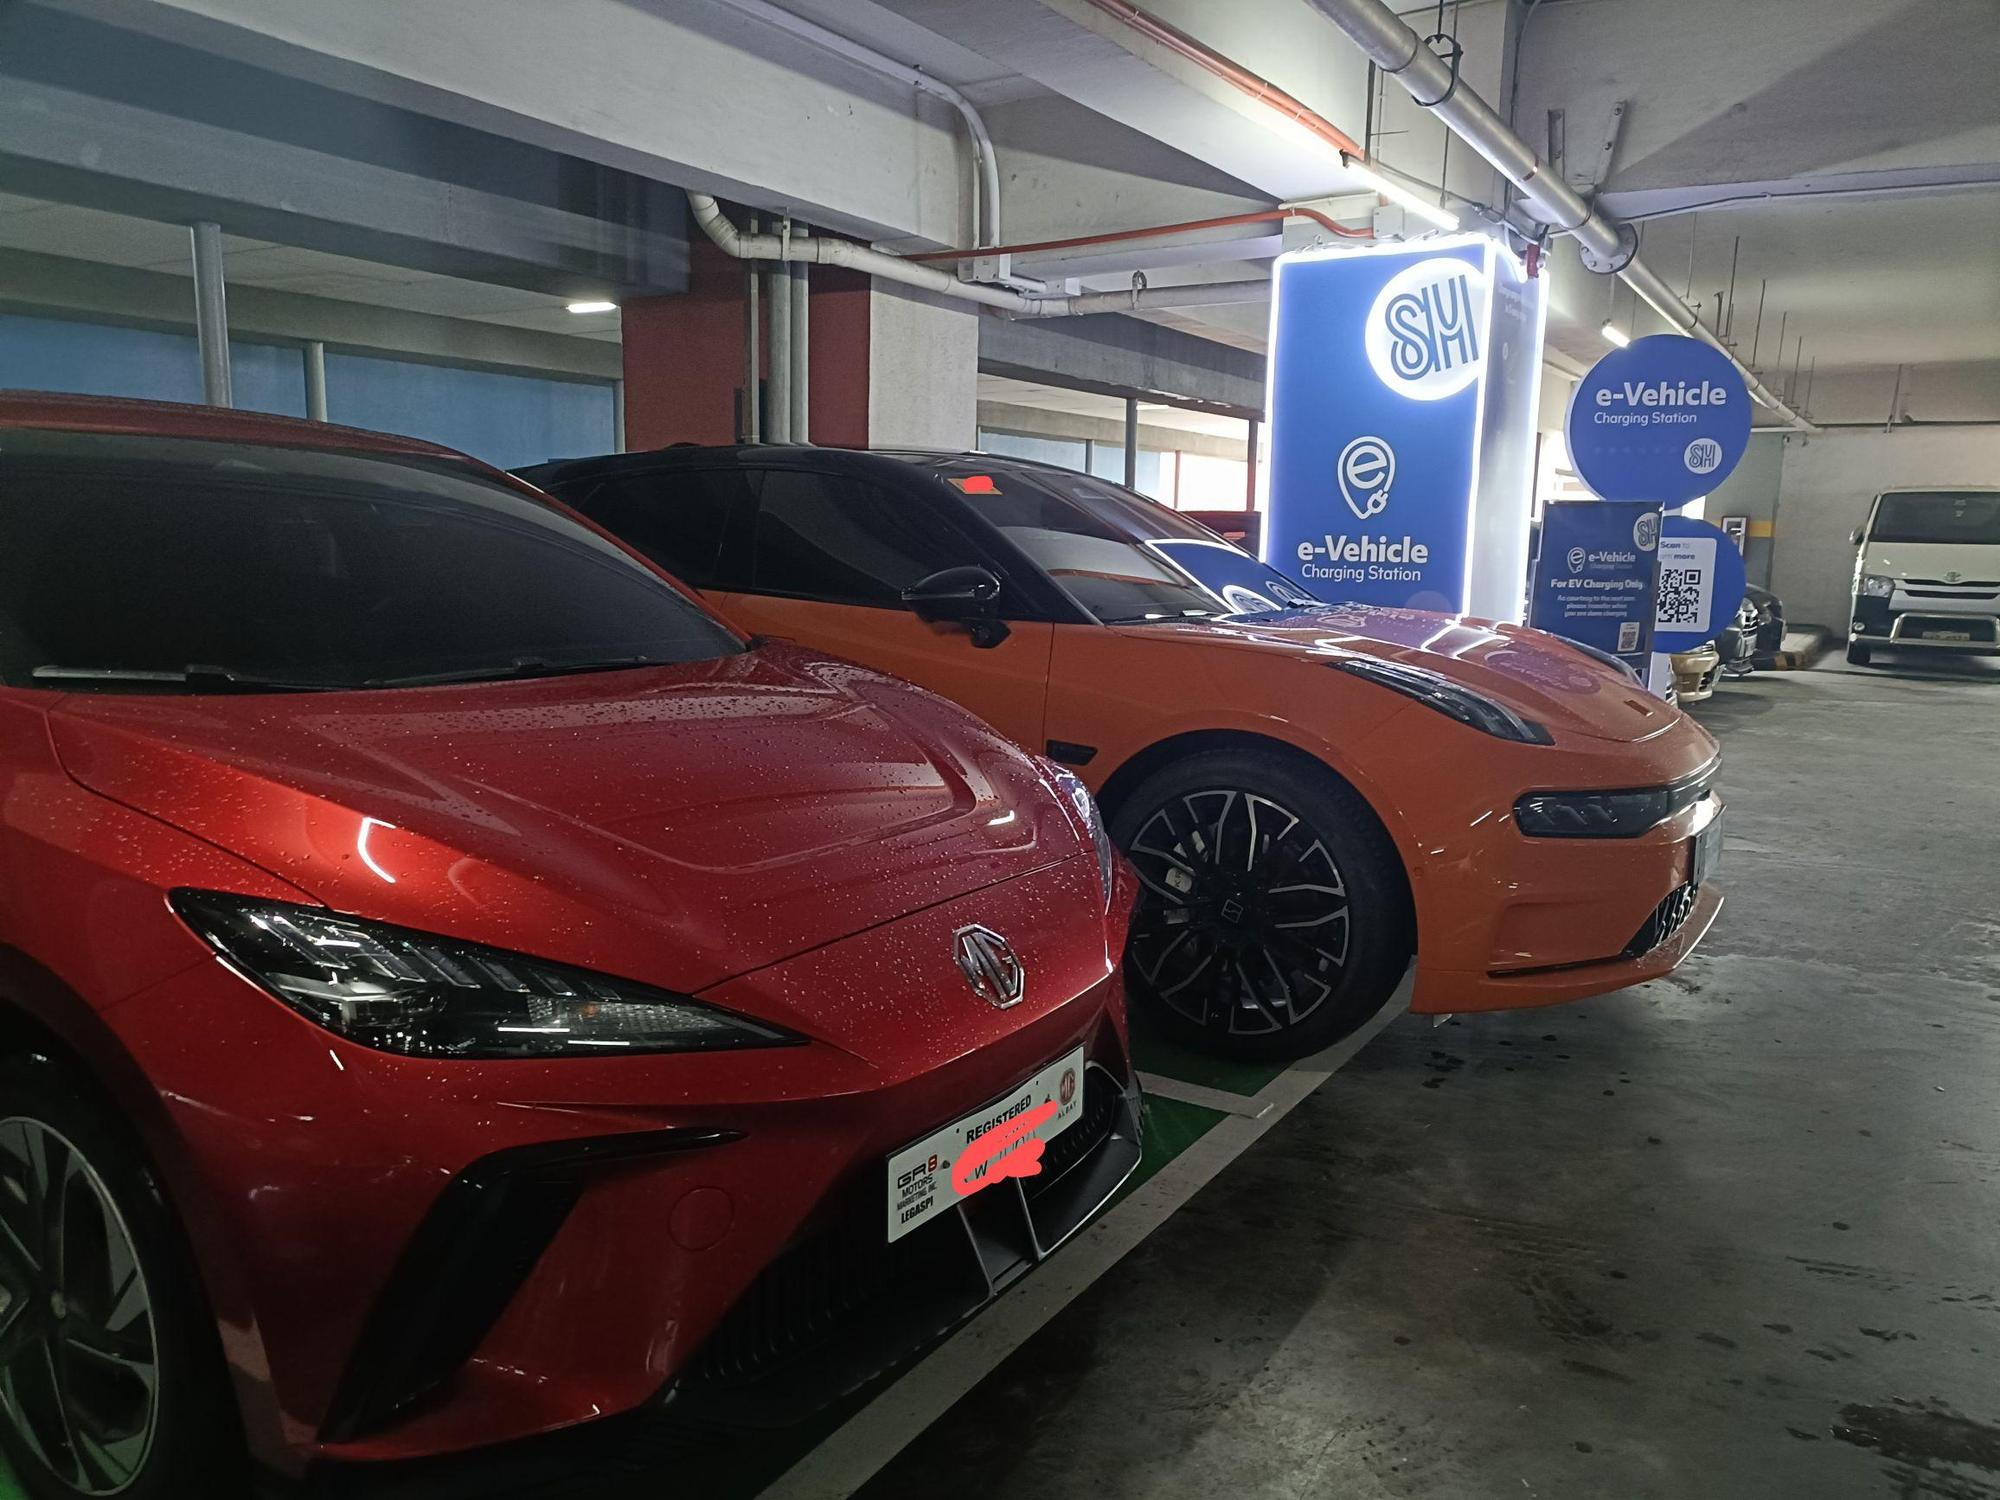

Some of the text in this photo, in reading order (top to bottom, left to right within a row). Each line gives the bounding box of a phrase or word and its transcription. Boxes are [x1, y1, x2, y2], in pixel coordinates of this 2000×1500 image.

[1384, 274, 1479, 381] SM
[1596, 380, 1727, 406] e-Vehicle
[1594, 411, 1697, 427] Charging Station
[1688, 443, 1716, 468] SM
[1297, 534, 1429, 564] e-Vehicle
[1588, 551, 1636, 563] e-Vehicle
[1660, 541, 1681, 549] Scan
[1301, 563, 1421, 582] Charging Station
[1551, 579, 1644, 591] For EV Charging Only
[966, 1094, 1032, 1145] REGISTERED
[897, 1154, 938, 1190] GR8
[901, 1173, 933, 1198] MOTORS
[901, 1195, 934, 1224] LEGASPI
